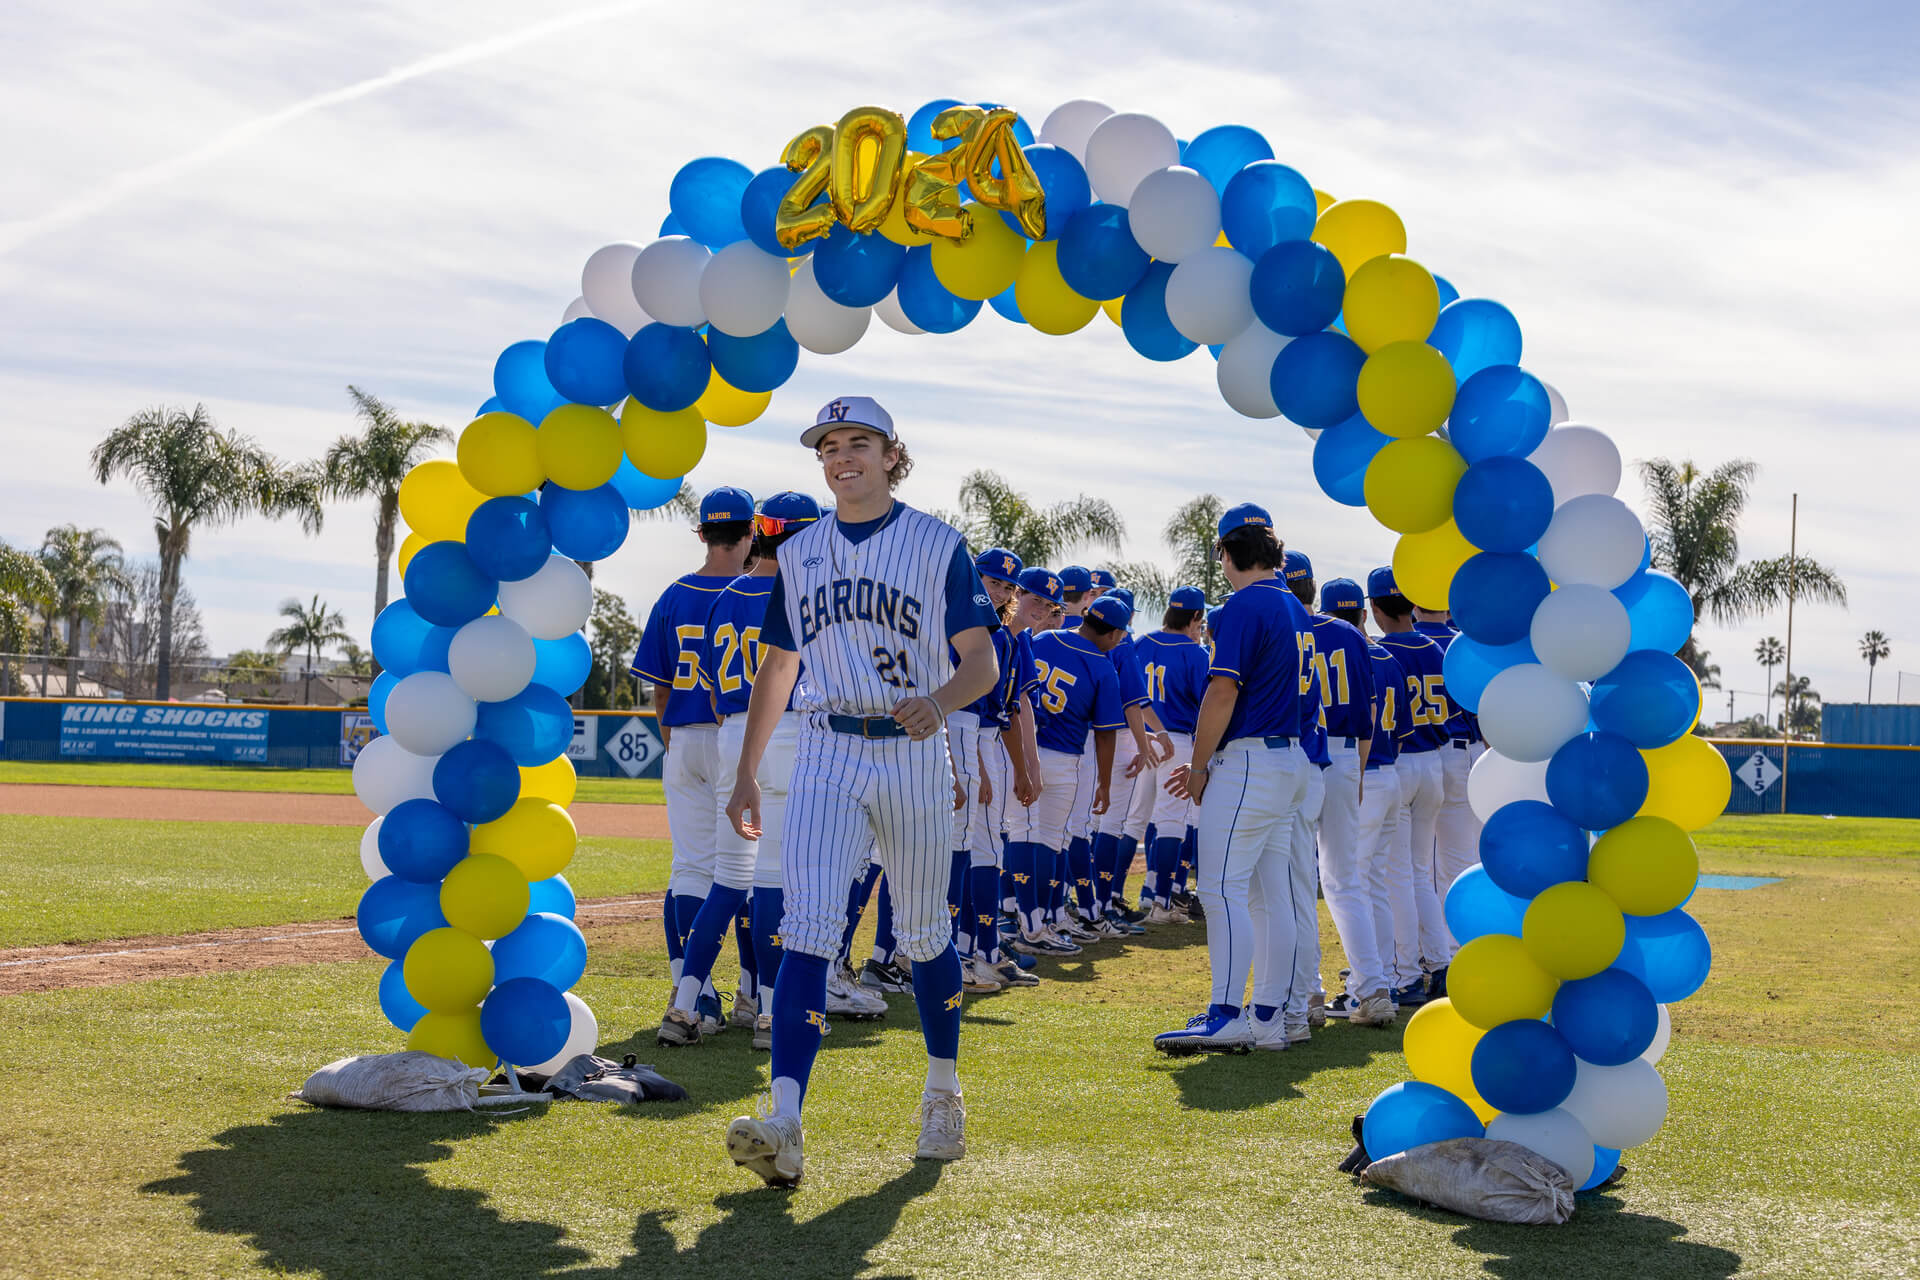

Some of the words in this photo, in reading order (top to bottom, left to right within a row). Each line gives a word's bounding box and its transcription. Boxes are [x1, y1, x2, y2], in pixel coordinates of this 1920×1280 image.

[776, 105, 1047, 250] 2024
[707, 511, 731, 520] BARONS
[713, 622, 770, 695] 20
[873, 645, 917, 689] 21
[1144, 661, 1166, 704] 11
[1406, 674, 1449, 727] 25
[63, 706, 137, 723] KING
[142, 708, 265, 728] SHOCKS
[619, 733, 649, 762] 85
[1753, 755, 1765, 792] 315
